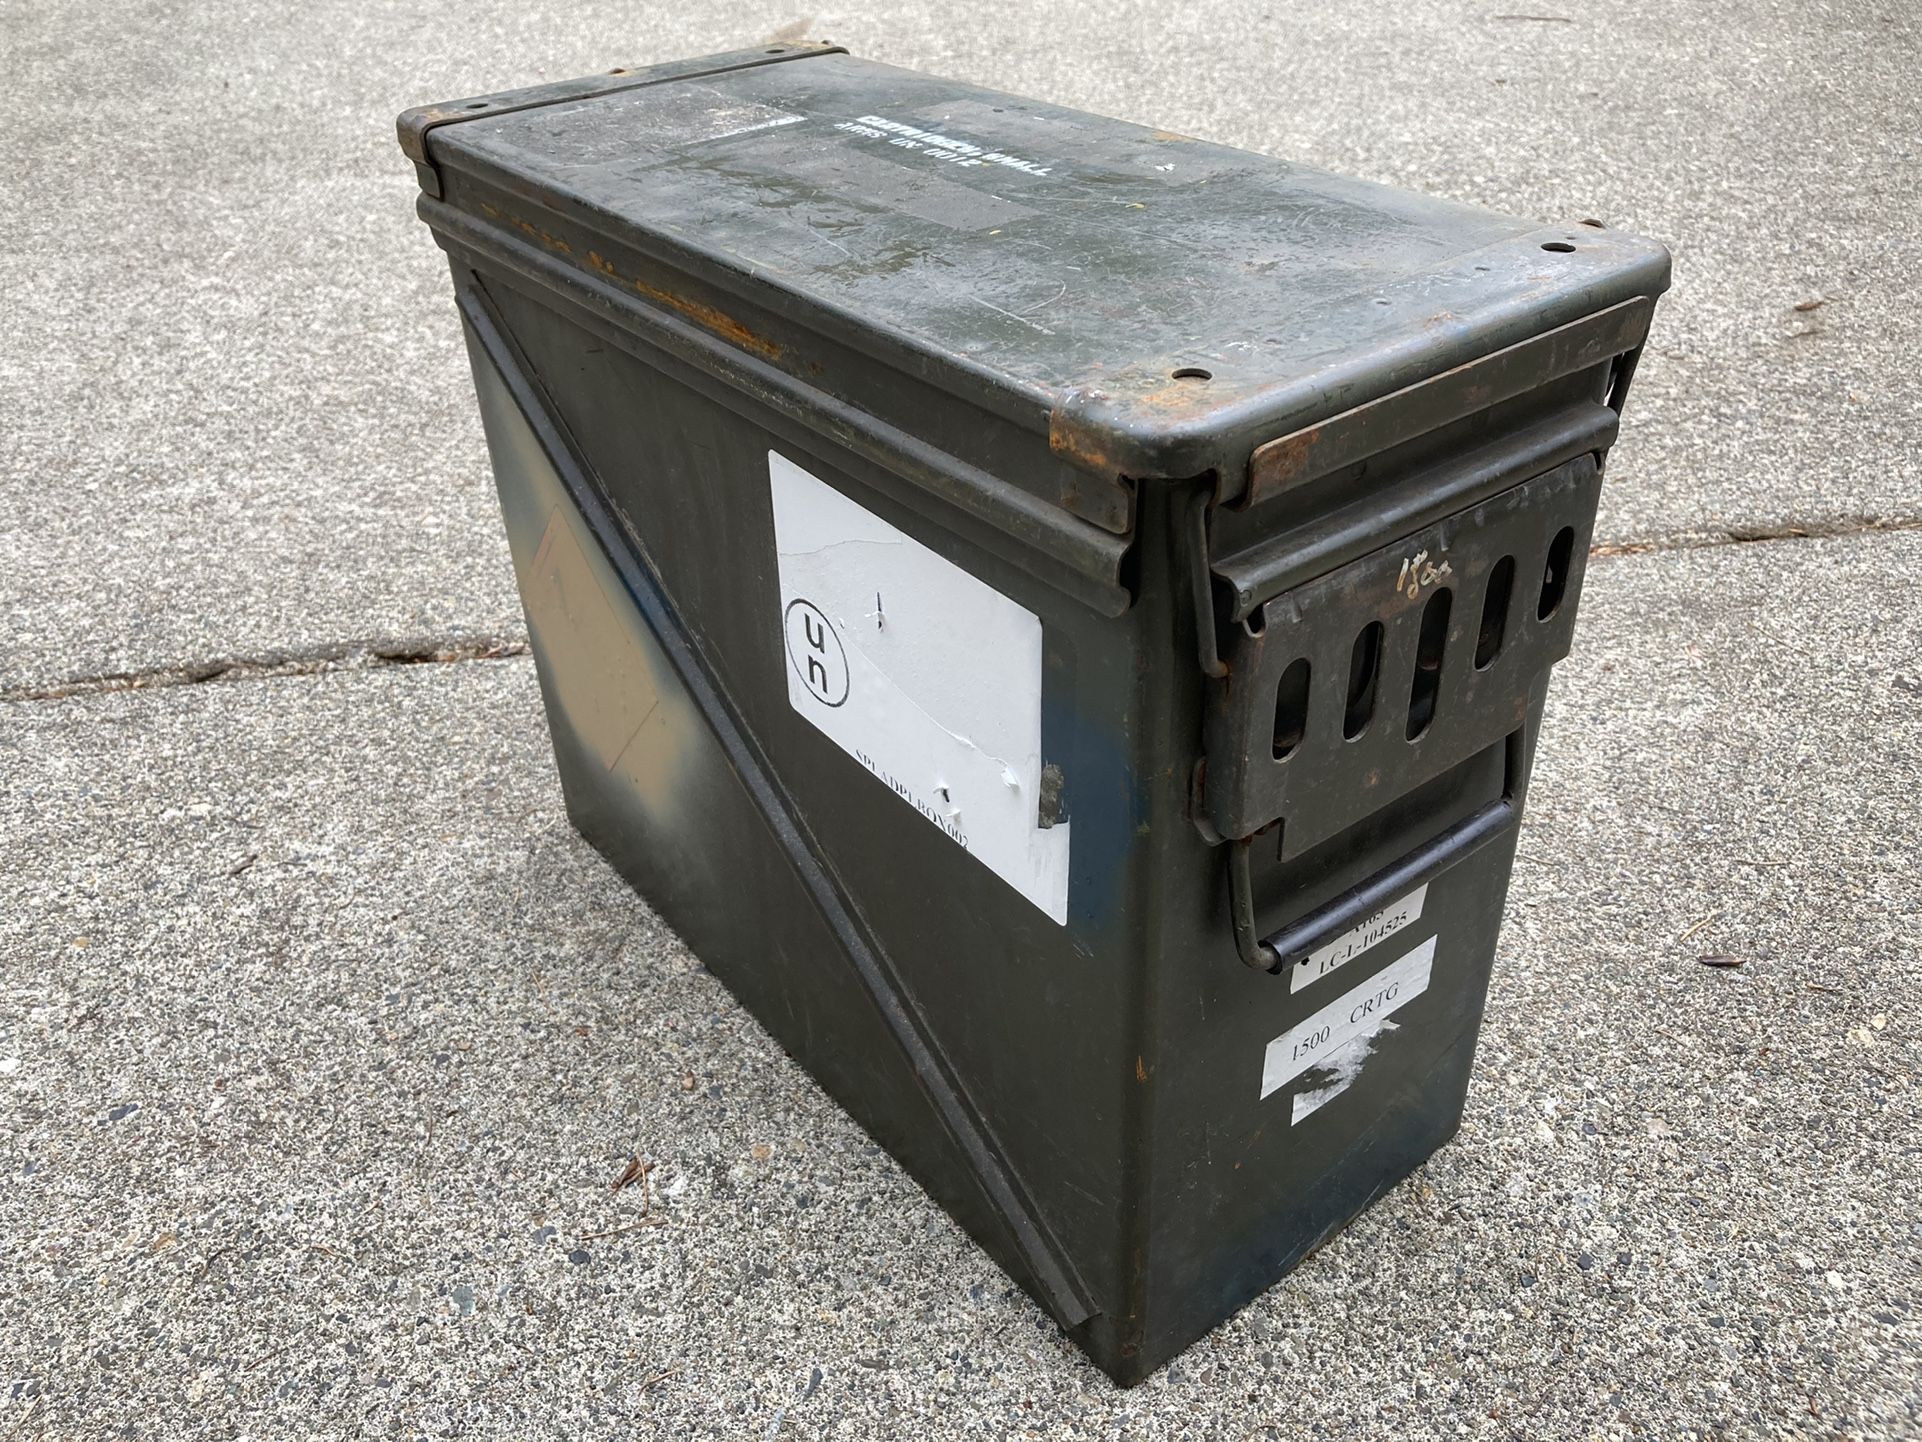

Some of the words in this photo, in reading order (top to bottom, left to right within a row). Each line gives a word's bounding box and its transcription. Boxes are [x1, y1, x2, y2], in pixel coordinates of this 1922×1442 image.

[922, 147, 982, 168] 0012
[1292, 1024, 1331, 1062] 1500
[1349, 981, 1400, 1025] CRTG
